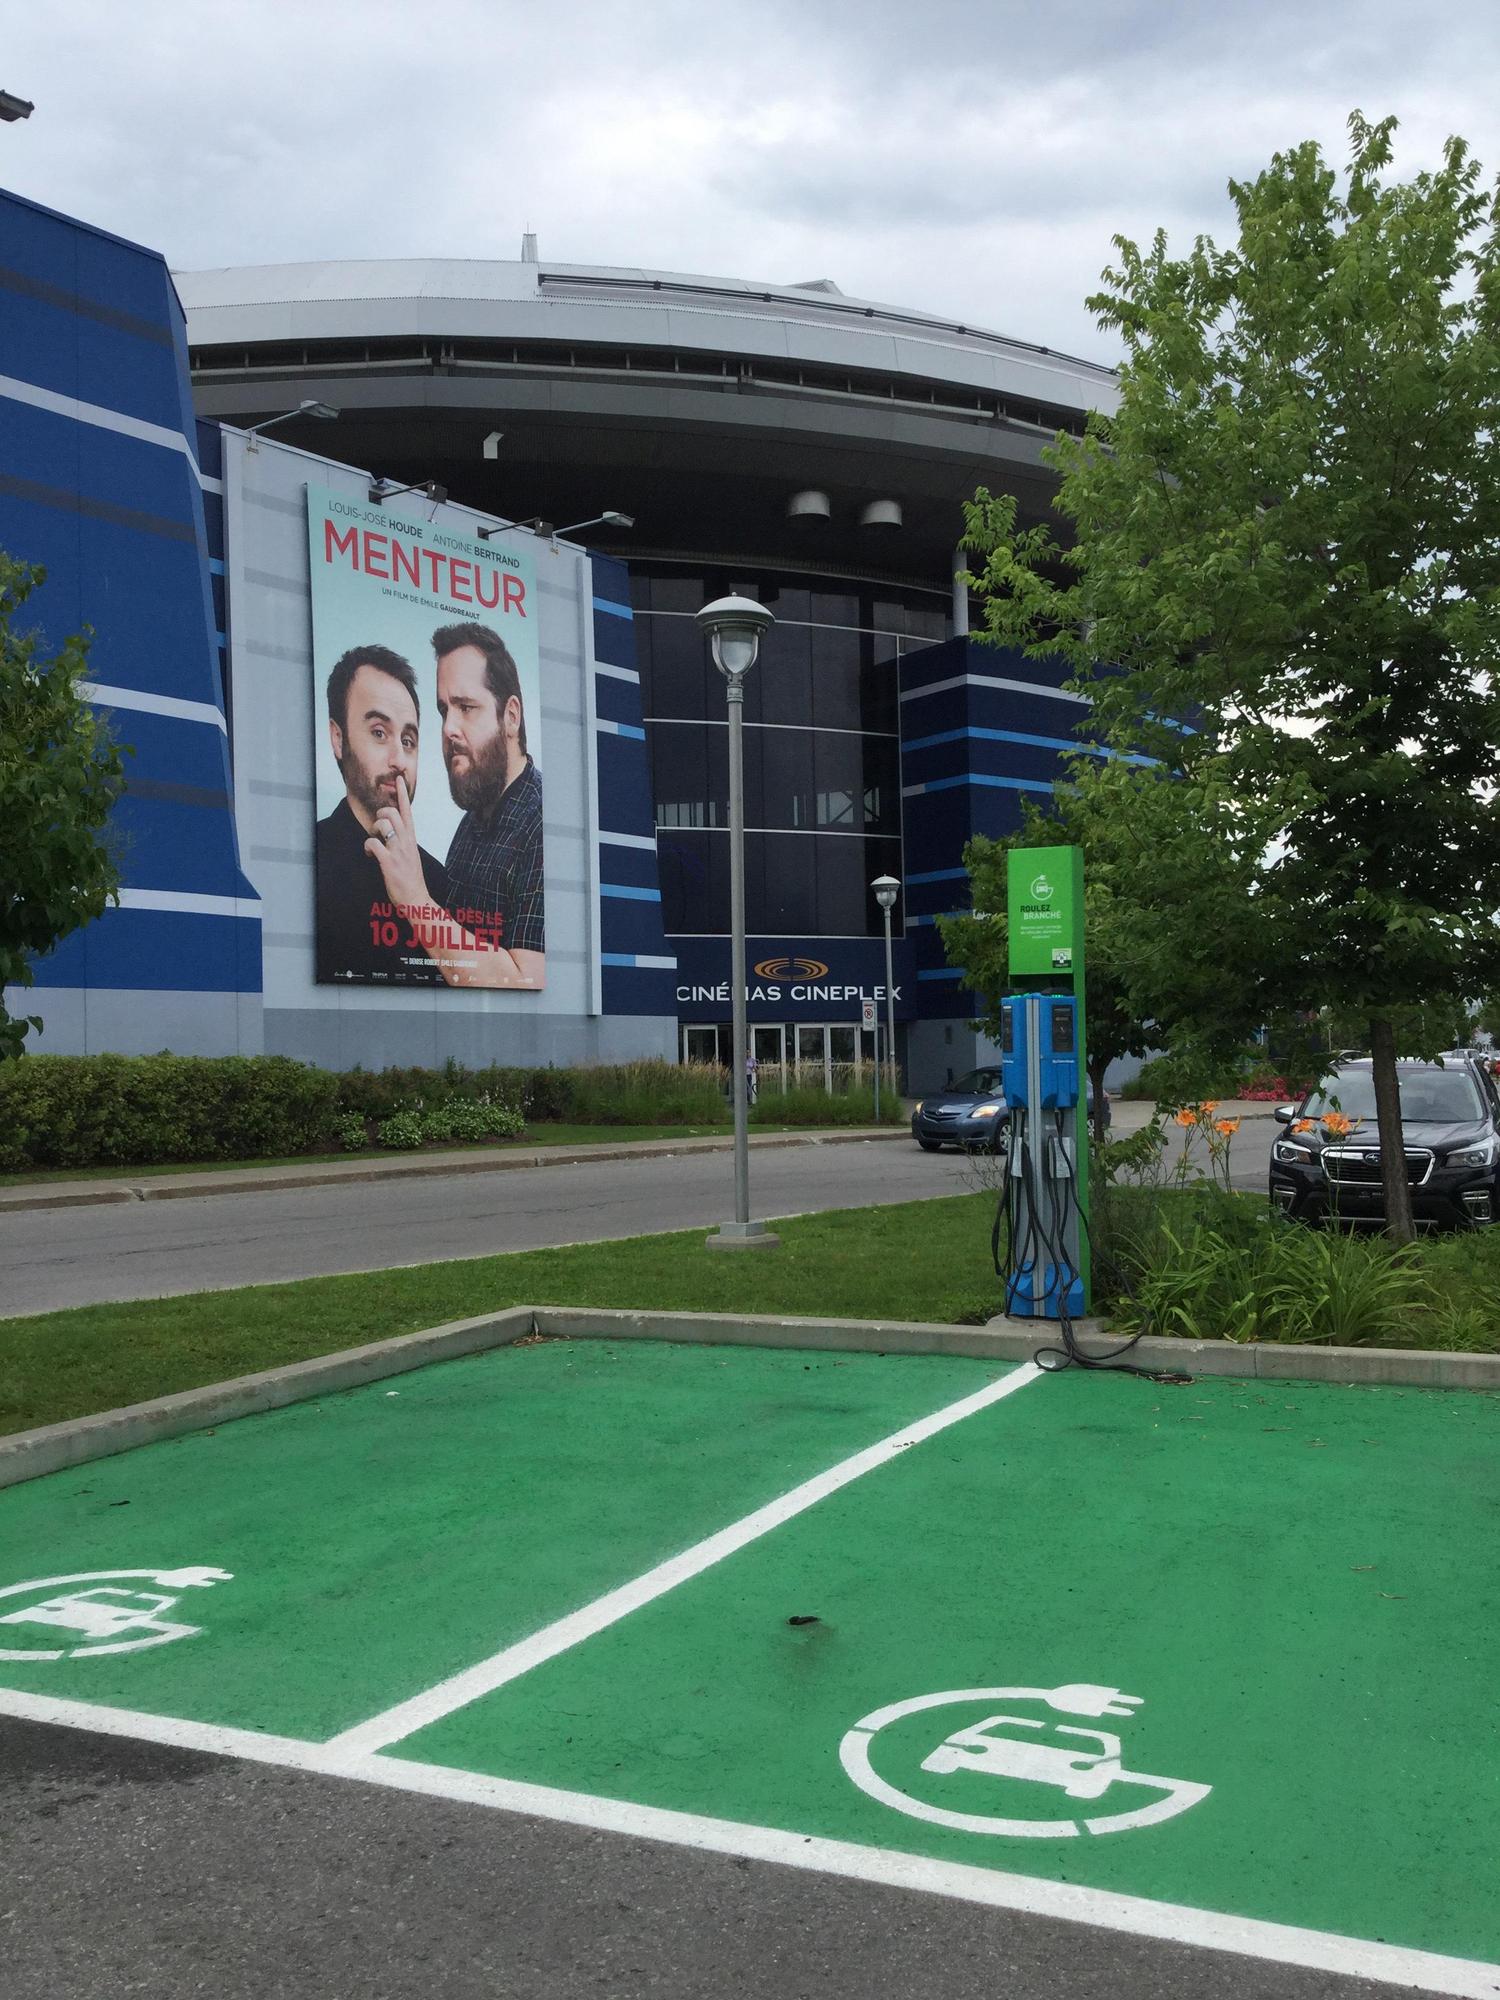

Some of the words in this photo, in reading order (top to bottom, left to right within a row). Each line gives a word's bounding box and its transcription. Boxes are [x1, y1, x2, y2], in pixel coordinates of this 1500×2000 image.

[329, 500, 387, 527] LOUIS-JOSÉ
[389, 520, 423, 539] HOUDE
[432, 533, 473, 555] ANTOINE
[474, 547, 520, 568] BERTRAND
[324, 518, 527, 618] MENTEUR
[382, 587, 392, 596] UN
[393, 590, 409, 601] FILM
[410, 594, 419, 604] DE
[440, 604, 480, 619] GAUDREAULT
[370, 903, 392, 917] AU
[396, 903, 452, 922] CINÉMA
[456, 907, 484, 924] DÈS
[486, 912, 503, 926] LE
[1020, 904, 1051, 912] ROULEZ
[369, 920, 398, 946] 10
[405, 925, 503, 953] JUILLET
[676, 981, 782, 1001] CINÉAS
[790, 986, 902, 1001] CINEPLEX
